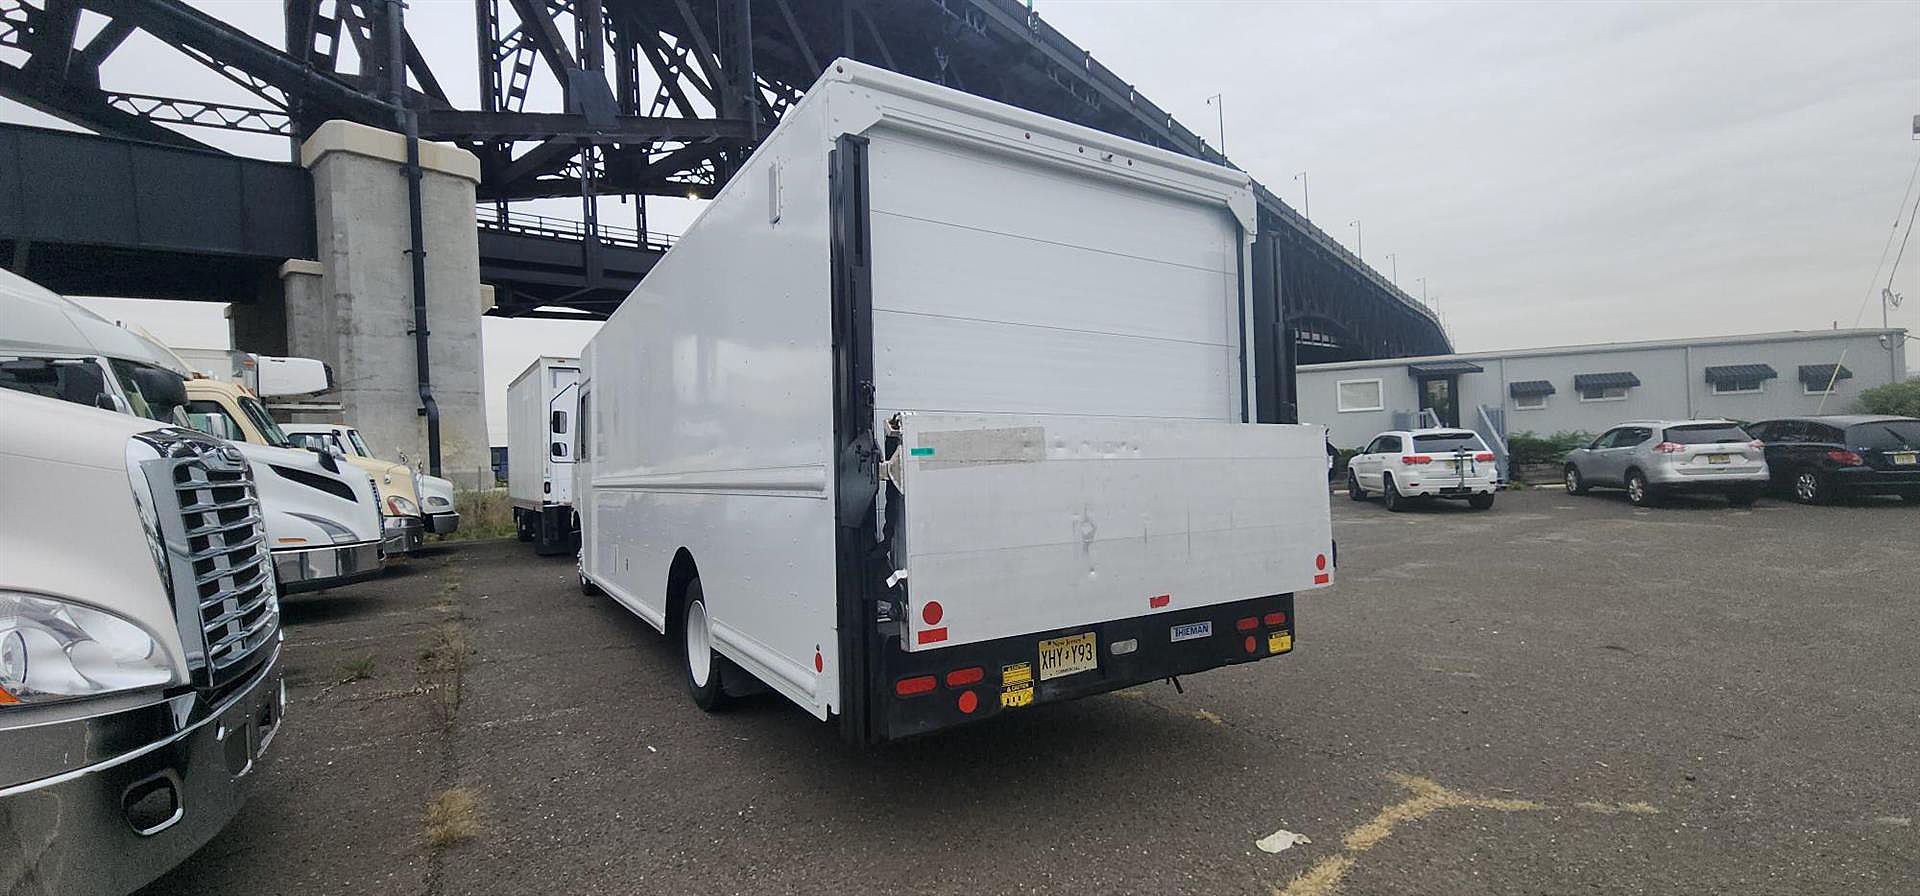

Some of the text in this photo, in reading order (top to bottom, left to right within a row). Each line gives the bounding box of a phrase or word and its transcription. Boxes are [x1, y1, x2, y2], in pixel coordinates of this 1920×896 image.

[1173, 623, 1209, 638] THIEMAN
[1041, 643, 1093, 670] XHY Y93
